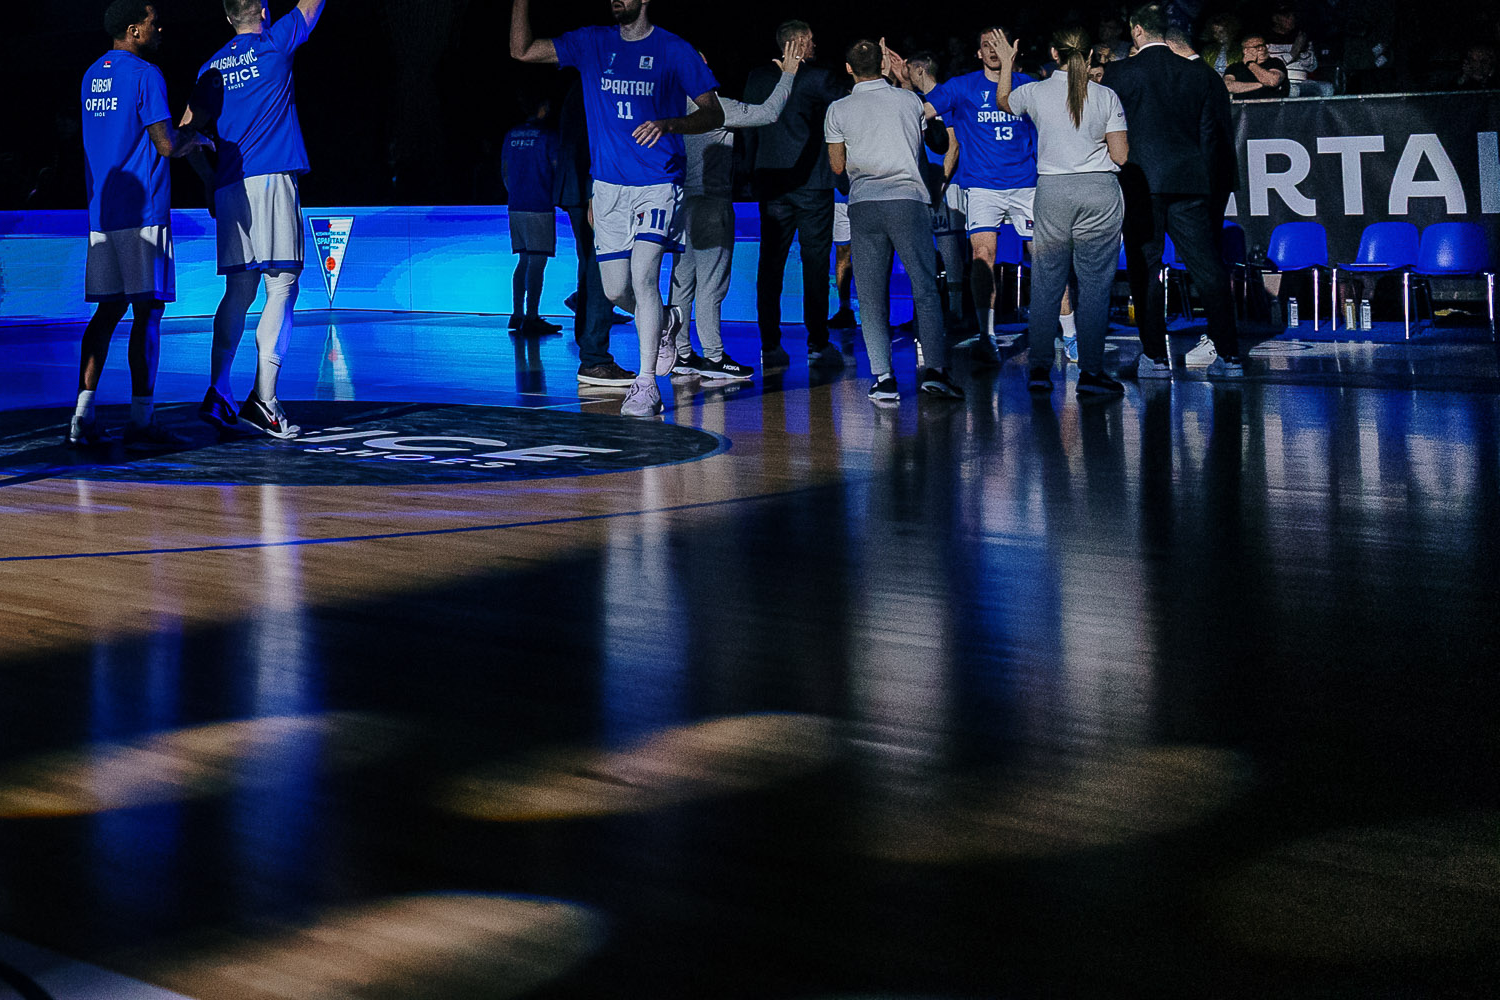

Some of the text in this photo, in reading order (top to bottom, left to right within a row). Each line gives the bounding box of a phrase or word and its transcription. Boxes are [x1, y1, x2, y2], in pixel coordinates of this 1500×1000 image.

[601, 77, 654, 96] SPARTAK
[85, 97, 118, 111] OFFICE
[616, 101, 634, 120] 11
[994, 126, 1014, 141] 13
[1224, 131, 1500, 217] RTA
[650, 208, 667, 231] 11
